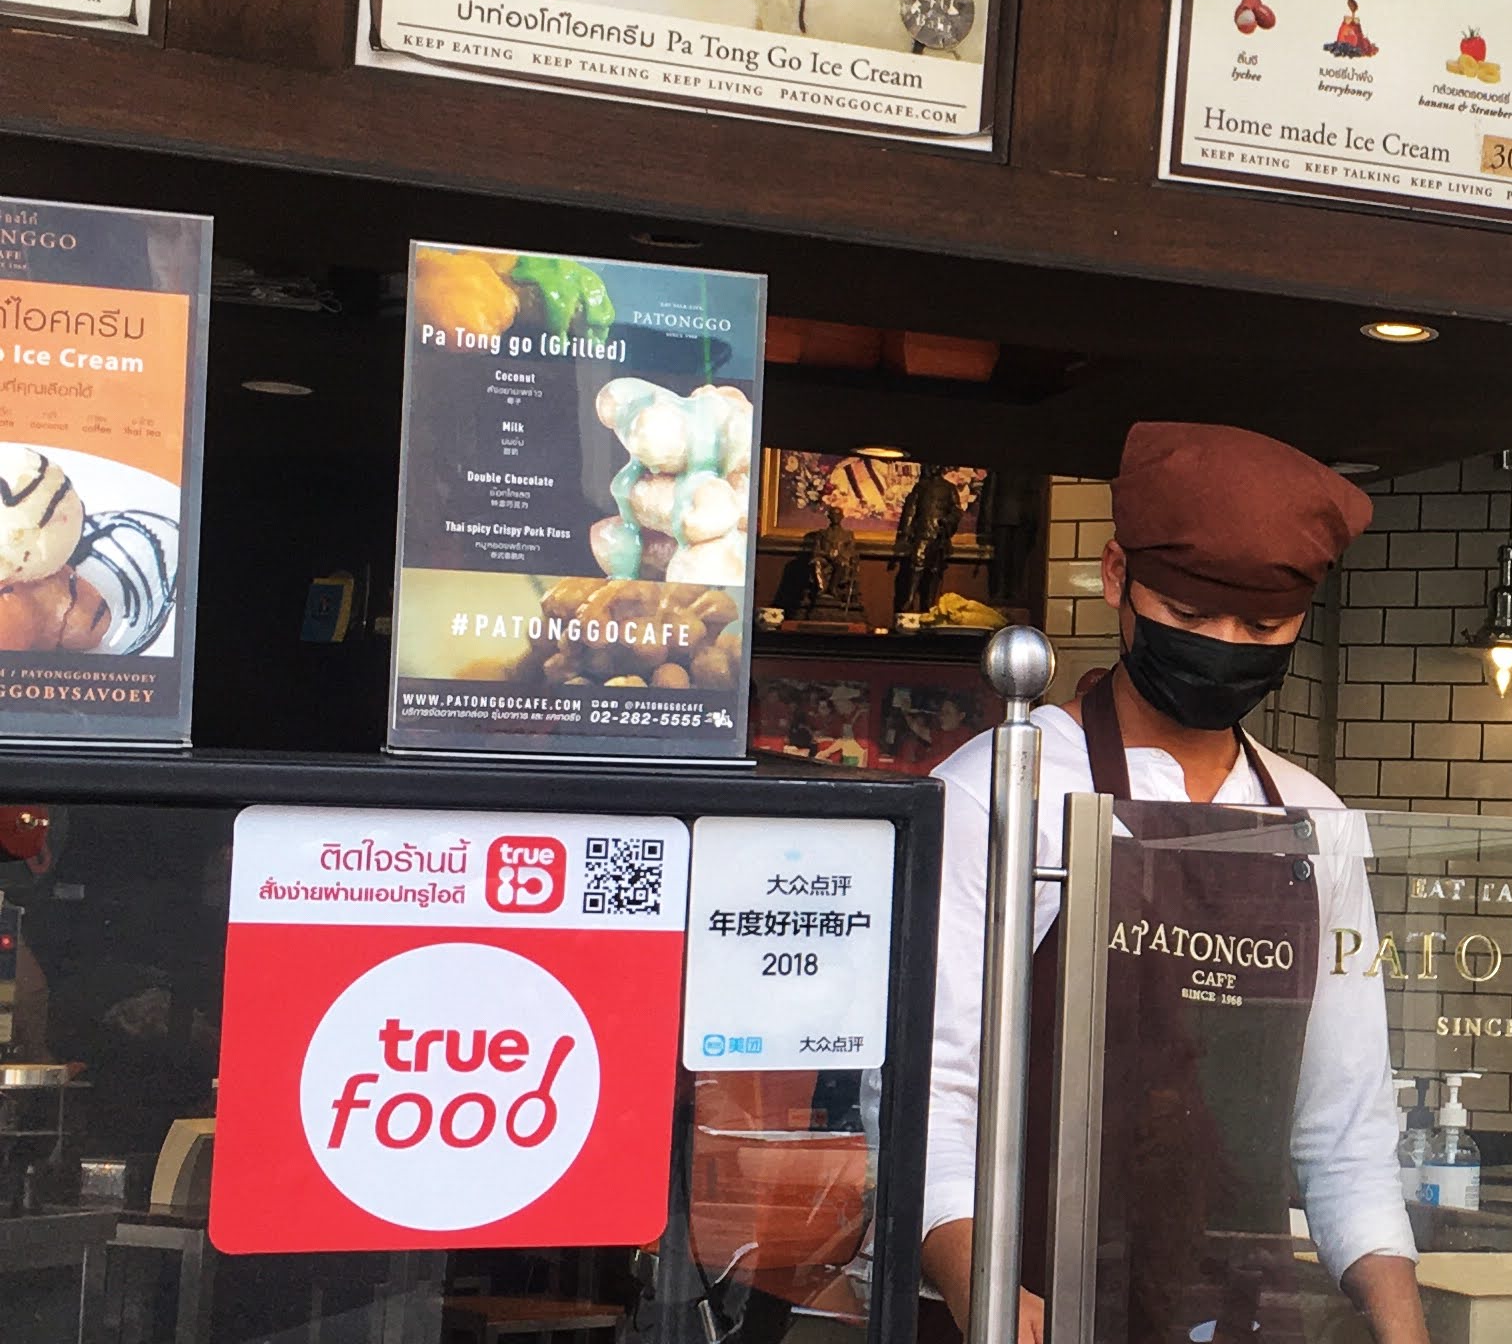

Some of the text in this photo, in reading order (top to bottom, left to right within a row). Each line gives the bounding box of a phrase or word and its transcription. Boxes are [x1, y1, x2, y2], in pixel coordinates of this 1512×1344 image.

[667, 29, 693, 56] Pa
[701, 35, 760, 72] Tong
[767, 46, 803, 73] Go
[810, 52, 843, 77] Ice
[849, 58, 924, 90] Cream
[403, 33, 959, 125] KEEP EATING KEEP TALKING KEEP LIVING PATONGGOCAFE.COM
[1231, 67, 1262, 82] lychee
[1418, 96, 1455, 112] banana
[1203, 106, 1273, 139] Home
[1280, 115, 1338, 148] made
[1344, 127, 1377, 152] Ice
[1381, 132, 1452, 165] Cream
[1201, 147, 1235, 162] KEEP
[1240, 152, 1291, 170] EATING
[1305, 161, 1339, 177] KEEP
[1343, 166, 1401, 185] TALKING
[1410, 176, 1443, 191] KEEP
[1447, 181, 1493, 198] LIVING
[633, 310, 732, 332] PATONGGO
[421, 324, 627, 363] Pa Tong go (Grilled)
[14, 344, 143, 373] Ice Cream
[495, 369, 536, 384] Coconut
[502, 421, 525, 433] Milk
[467, 470, 554, 487] Double Chocolate
[445, 520, 571, 539] Thai spicy Crispy Pork Floss
[451, 613, 691, 648] #PATONGGOCAFE
[21, 669, 157, 683] PATONGGOBYSAVOEY
[402, 693, 582, 712] WWW.PATONGGOCAFE.COM
[590, 710, 702, 727] 02-282-5555
[320, 838, 471, 874] ติดใจร้านนี้
[500, 843, 555, 865] true
[766, 873, 853, 897] 大众点评
[708, 909, 872, 940] 年度好评商户
[761, 952, 818, 977] 2018
[1192, 970, 1237, 989] CAFE
[1181, 988, 1243, 1006] SINCE 1968
[377, 1018, 530, 1073] true
[728, 1036, 764, 1054] 美团
[799, 1035, 865, 1054] 大众点评
